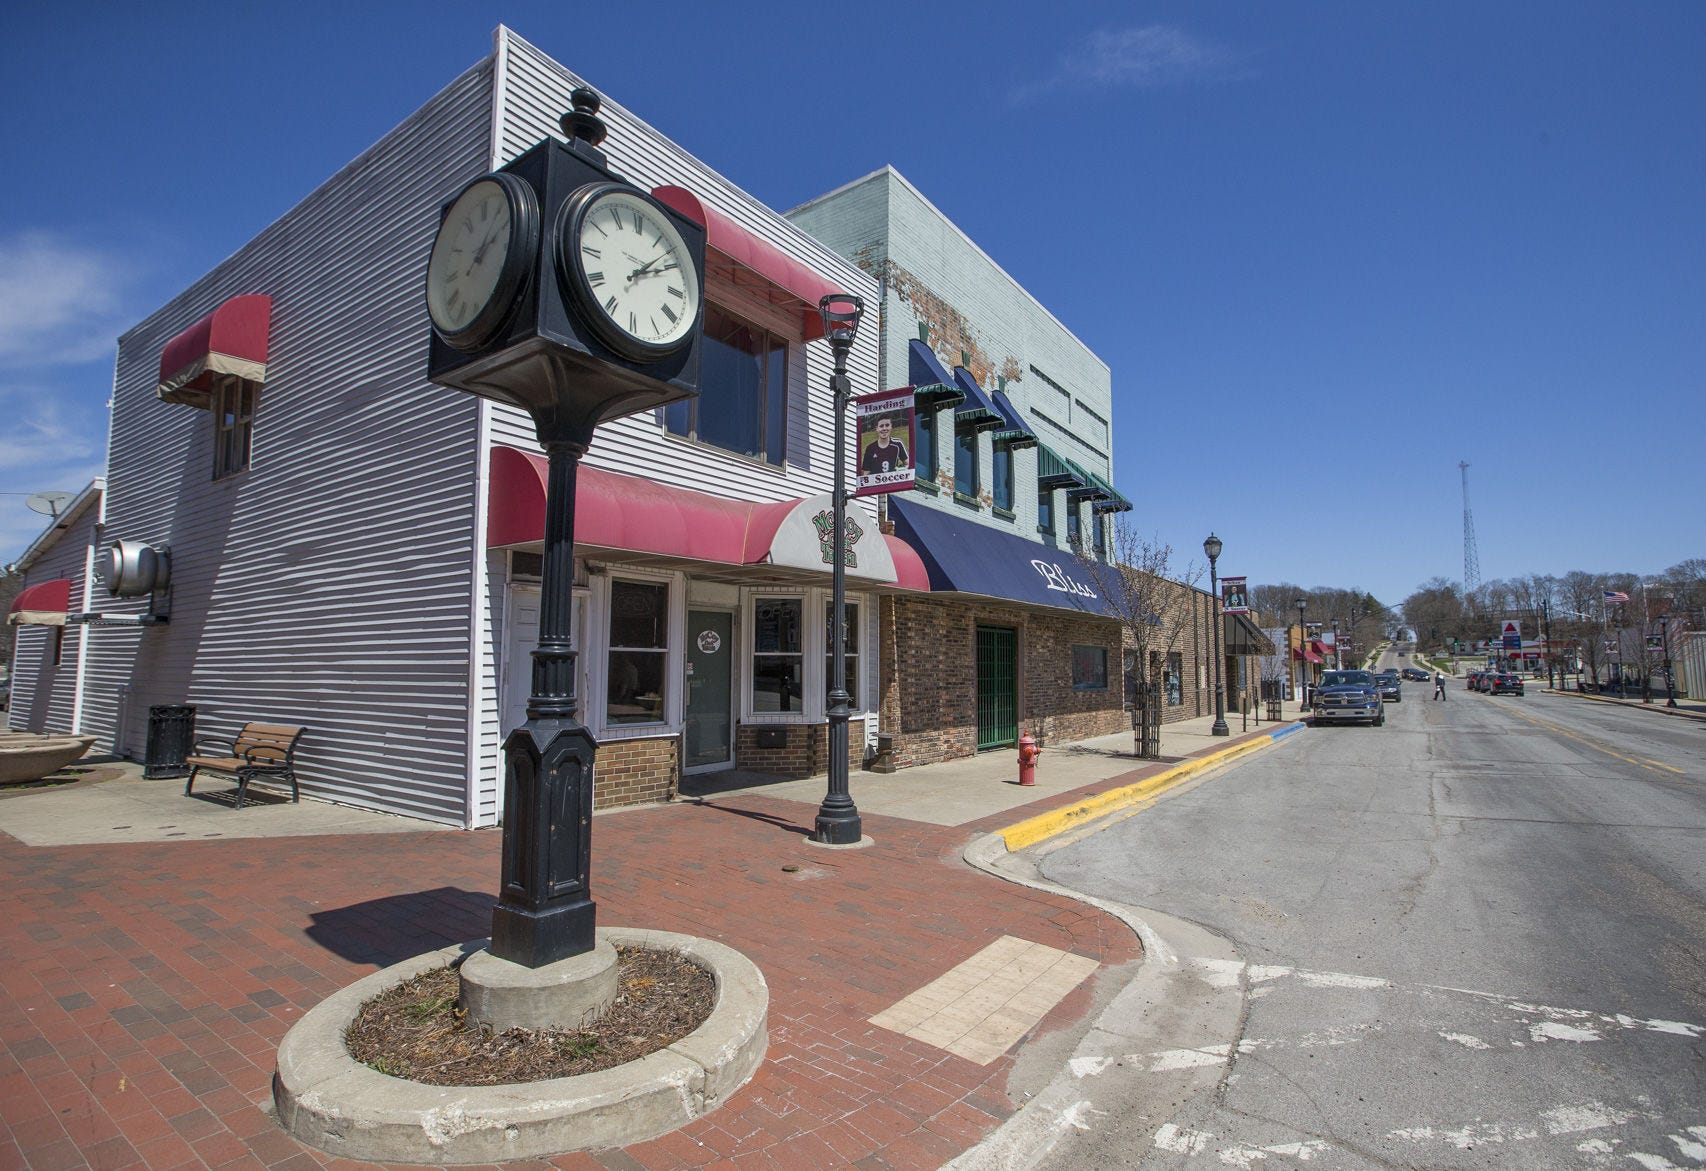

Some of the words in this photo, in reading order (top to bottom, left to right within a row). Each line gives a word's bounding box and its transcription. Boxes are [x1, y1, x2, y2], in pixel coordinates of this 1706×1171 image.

[864, 399, 905, 413] Harding
[874, 472, 911, 484] Soccer
[811, 510, 864, 545] Mcoy
[1030, 559, 1098, 599] Bliss
